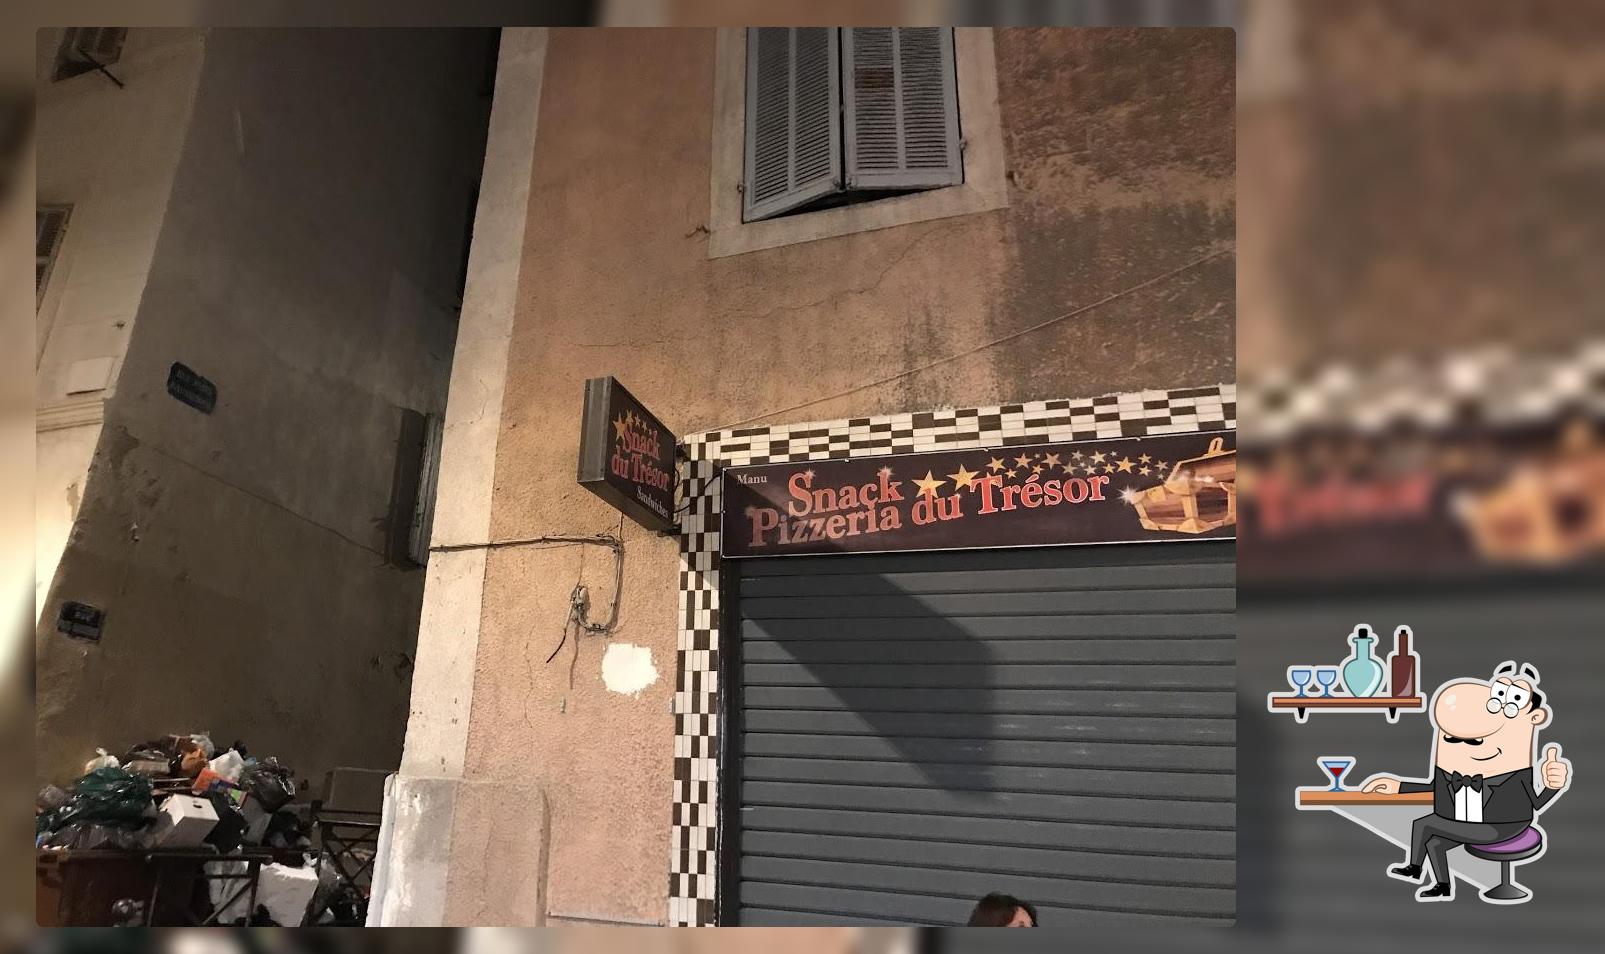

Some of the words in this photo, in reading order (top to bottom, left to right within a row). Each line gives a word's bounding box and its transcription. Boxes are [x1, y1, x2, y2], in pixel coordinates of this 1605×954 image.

[623, 429, 660, 460] Snack
[611, 445, 629, 480] du
[631, 453, 669, 491] Trésor
[737, 474, 767, 484] Manu
[637, 485, 668, 518] Sandwiches
[748, 504, 901, 547] Pizzeria
[911, 488, 964, 525] du
[970, 474, 1110, 515] Trésor
[788, 469, 905, 517] Snack
